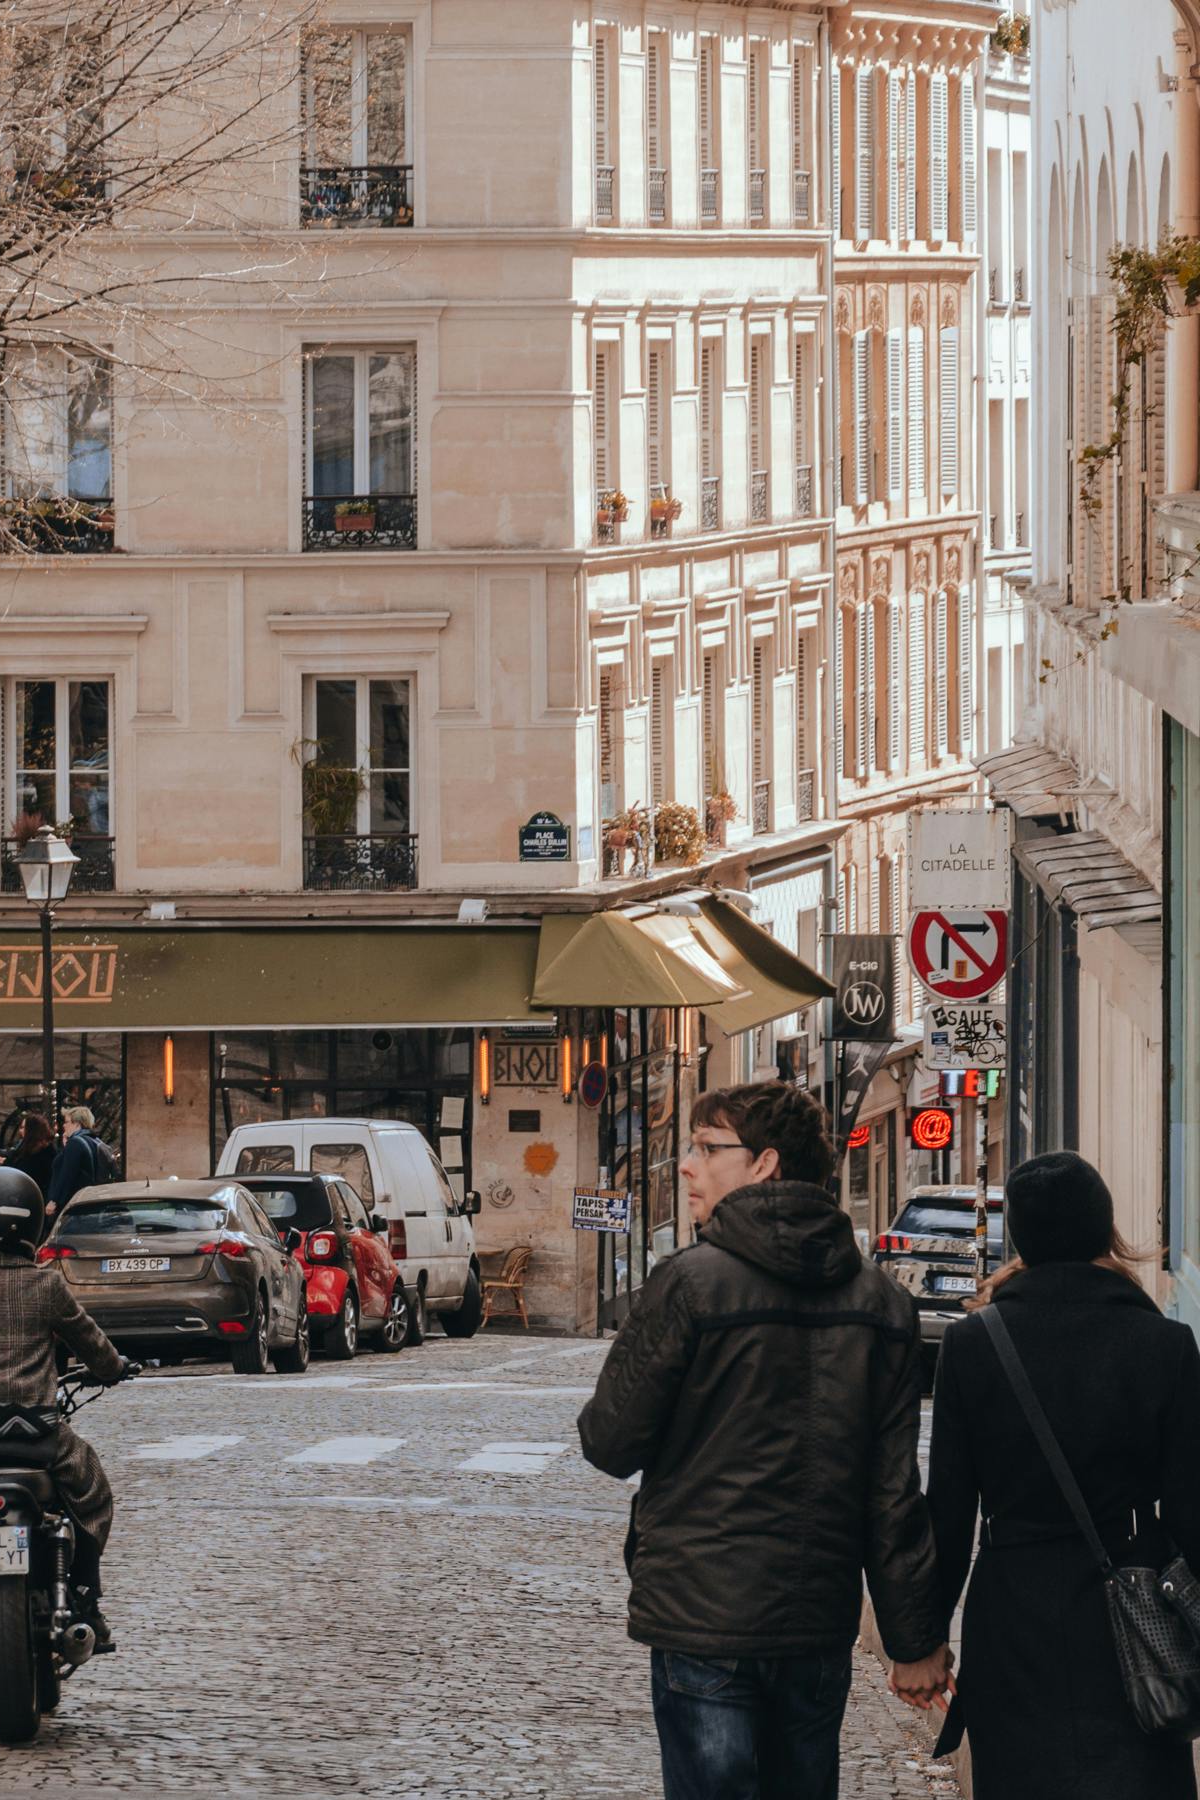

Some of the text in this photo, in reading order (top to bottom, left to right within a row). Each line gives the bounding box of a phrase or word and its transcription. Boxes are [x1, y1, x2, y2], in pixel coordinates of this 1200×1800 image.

[535, 831, 555, 839] PLACE
[949, 843, 968, 855] LA
[921, 859, 996, 872] CITADELLE
[848, 961, 879, 971] E-CIG
[848, 987, 882, 1018] JW
[947, 1011, 993, 1026] SAUF
[494, 1047, 558, 1082] BIJOU
[576, 1197, 604, 1208] TAPIS
[576, 1208, 604, 1219] PERSAN
